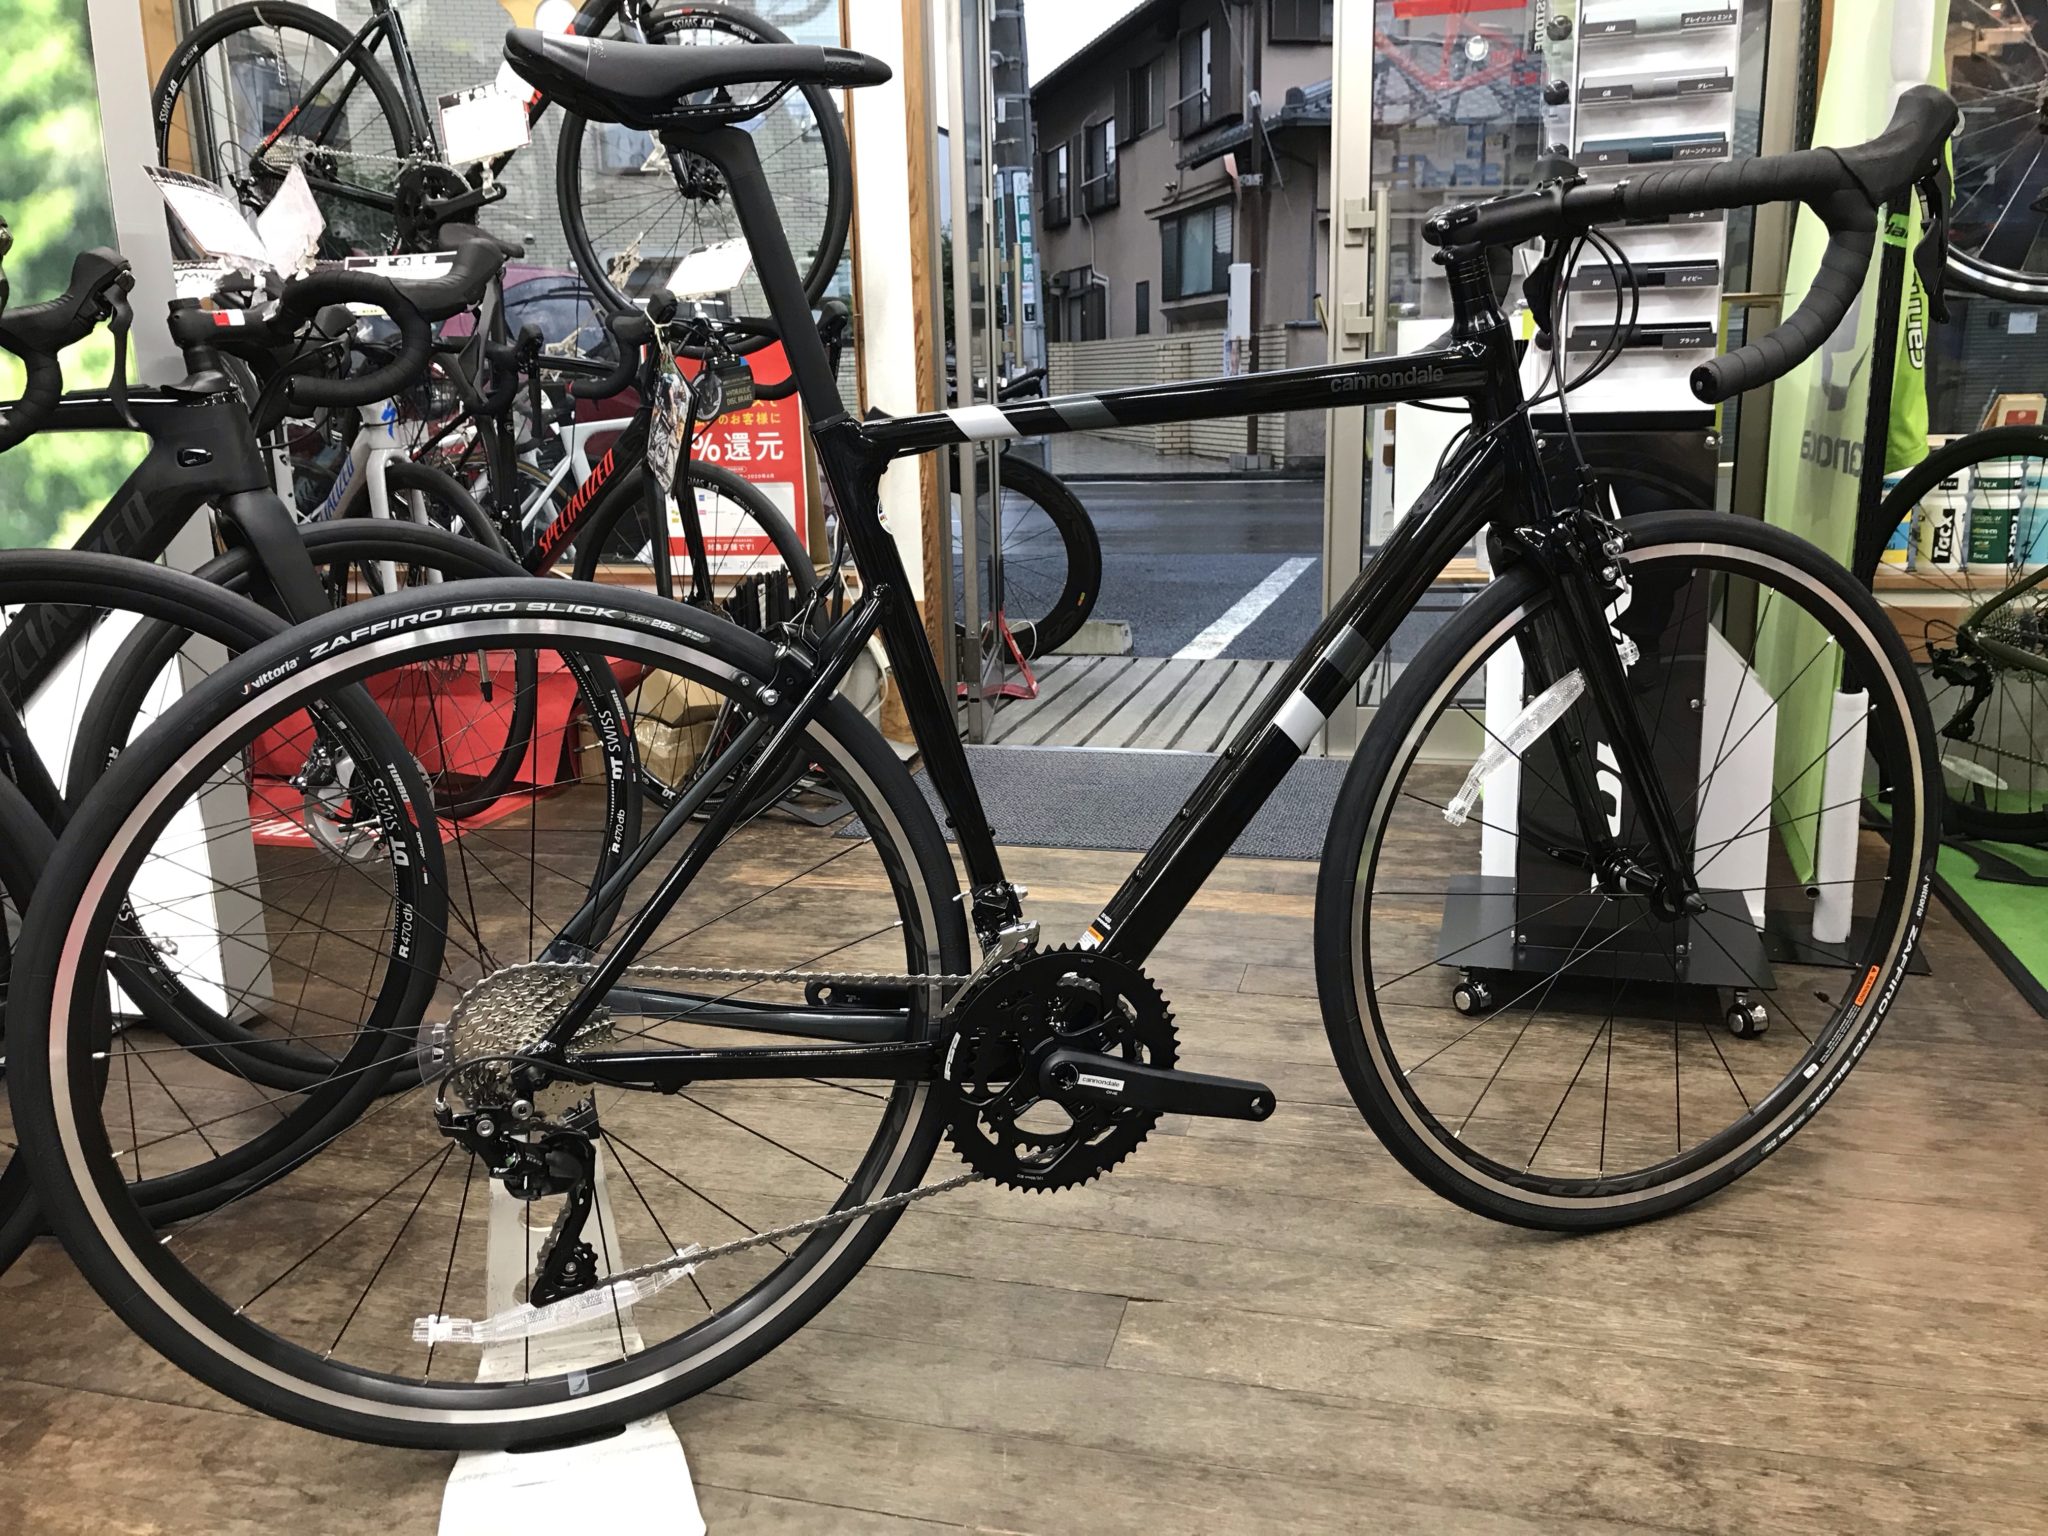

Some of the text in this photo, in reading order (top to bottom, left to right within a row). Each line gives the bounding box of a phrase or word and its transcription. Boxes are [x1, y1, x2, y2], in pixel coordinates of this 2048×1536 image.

[158, 94, 173, 123] SWISS
[1330, 364, 1445, 393] cannondale
[538, 447, 615, 559] SPECIALIZED
[1932, 515, 1954, 559] Tacx
[309, 609, 443, 660] ZAFFIRO
[450, 602, 517, 617] PRO
[525, 601, 617, 619] SLICK
[250, 656, 299, 690] vittoria
[610, 688, 625, 721] TURBO
[598, 710, 624, 780] DT SWISS
[386, 762, 411, 802] TURBO
[661, 788, 677, 801] DT
[374, 777, 410, 868] DT SWISS
[1878, 924, 1920, 1015] ZAFFIRO
[1852, 1016, 1880, 1058] PRO
[1081, 1075, 1121, 1089] cannondale
[1105, 1089, 1119, 1097] ONE
[1809, 1059, 1851, 1114] SLICK
